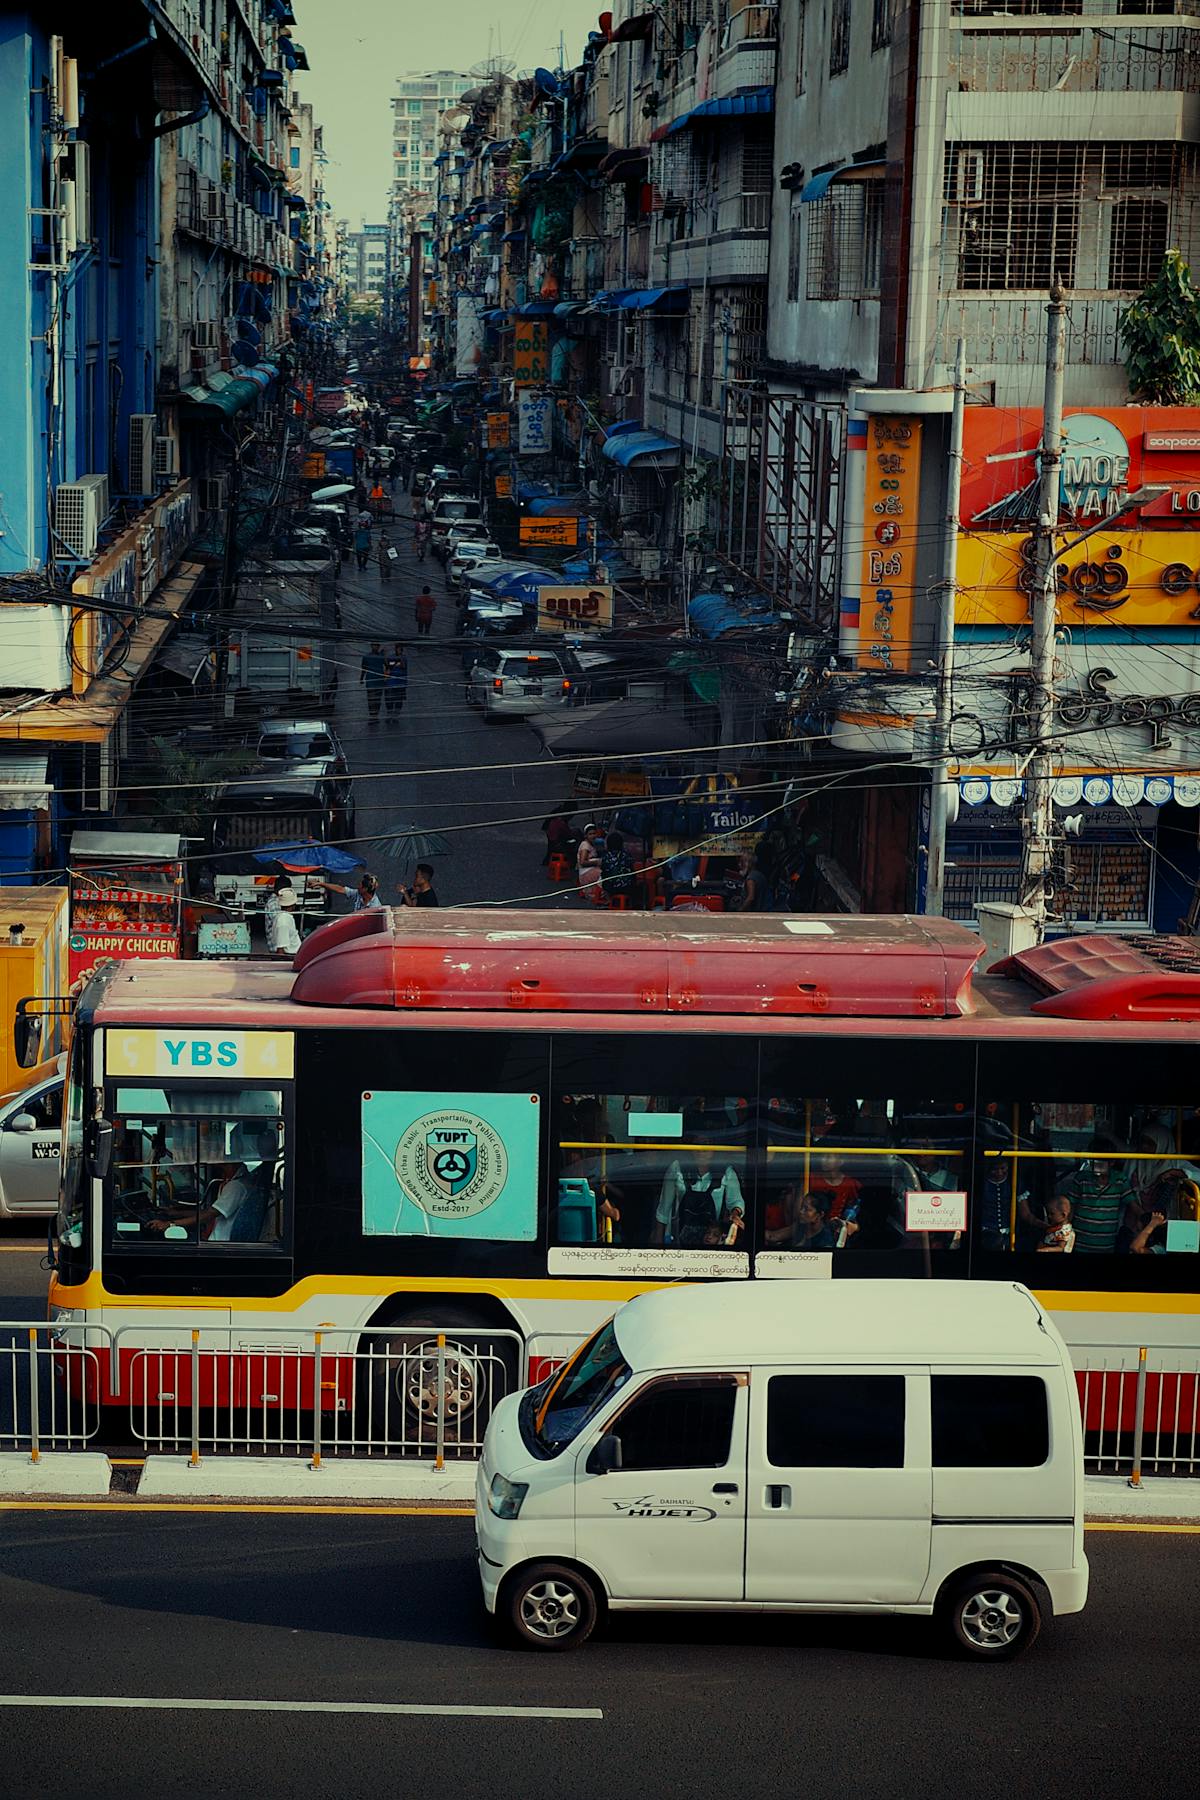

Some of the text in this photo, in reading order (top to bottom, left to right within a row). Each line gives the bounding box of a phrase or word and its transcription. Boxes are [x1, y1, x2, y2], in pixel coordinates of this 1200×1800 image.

[1063, 456, 1130, 486] MOE
[710, 811, 756, 828] Tailor
[87, 937, 176, 953] HAPPY CHICKEN
[163, 1040, 238, 1067] YBS
[420, 1115, 473, 1129] Transportation
[475, 1121, 495, 1144] Public
[404, 1129, 420, 1150] Public
[435, 1131, 468, 1144] YUPT
[400, 1154, 409, 1177] Urban
[492, 1144, 502, 1177] Company
[478, 1182, 501, 1206] Limited
[432, 1204, 470, 1213] Estd-2017
[627, 1509, 698, 1517] HIJET
